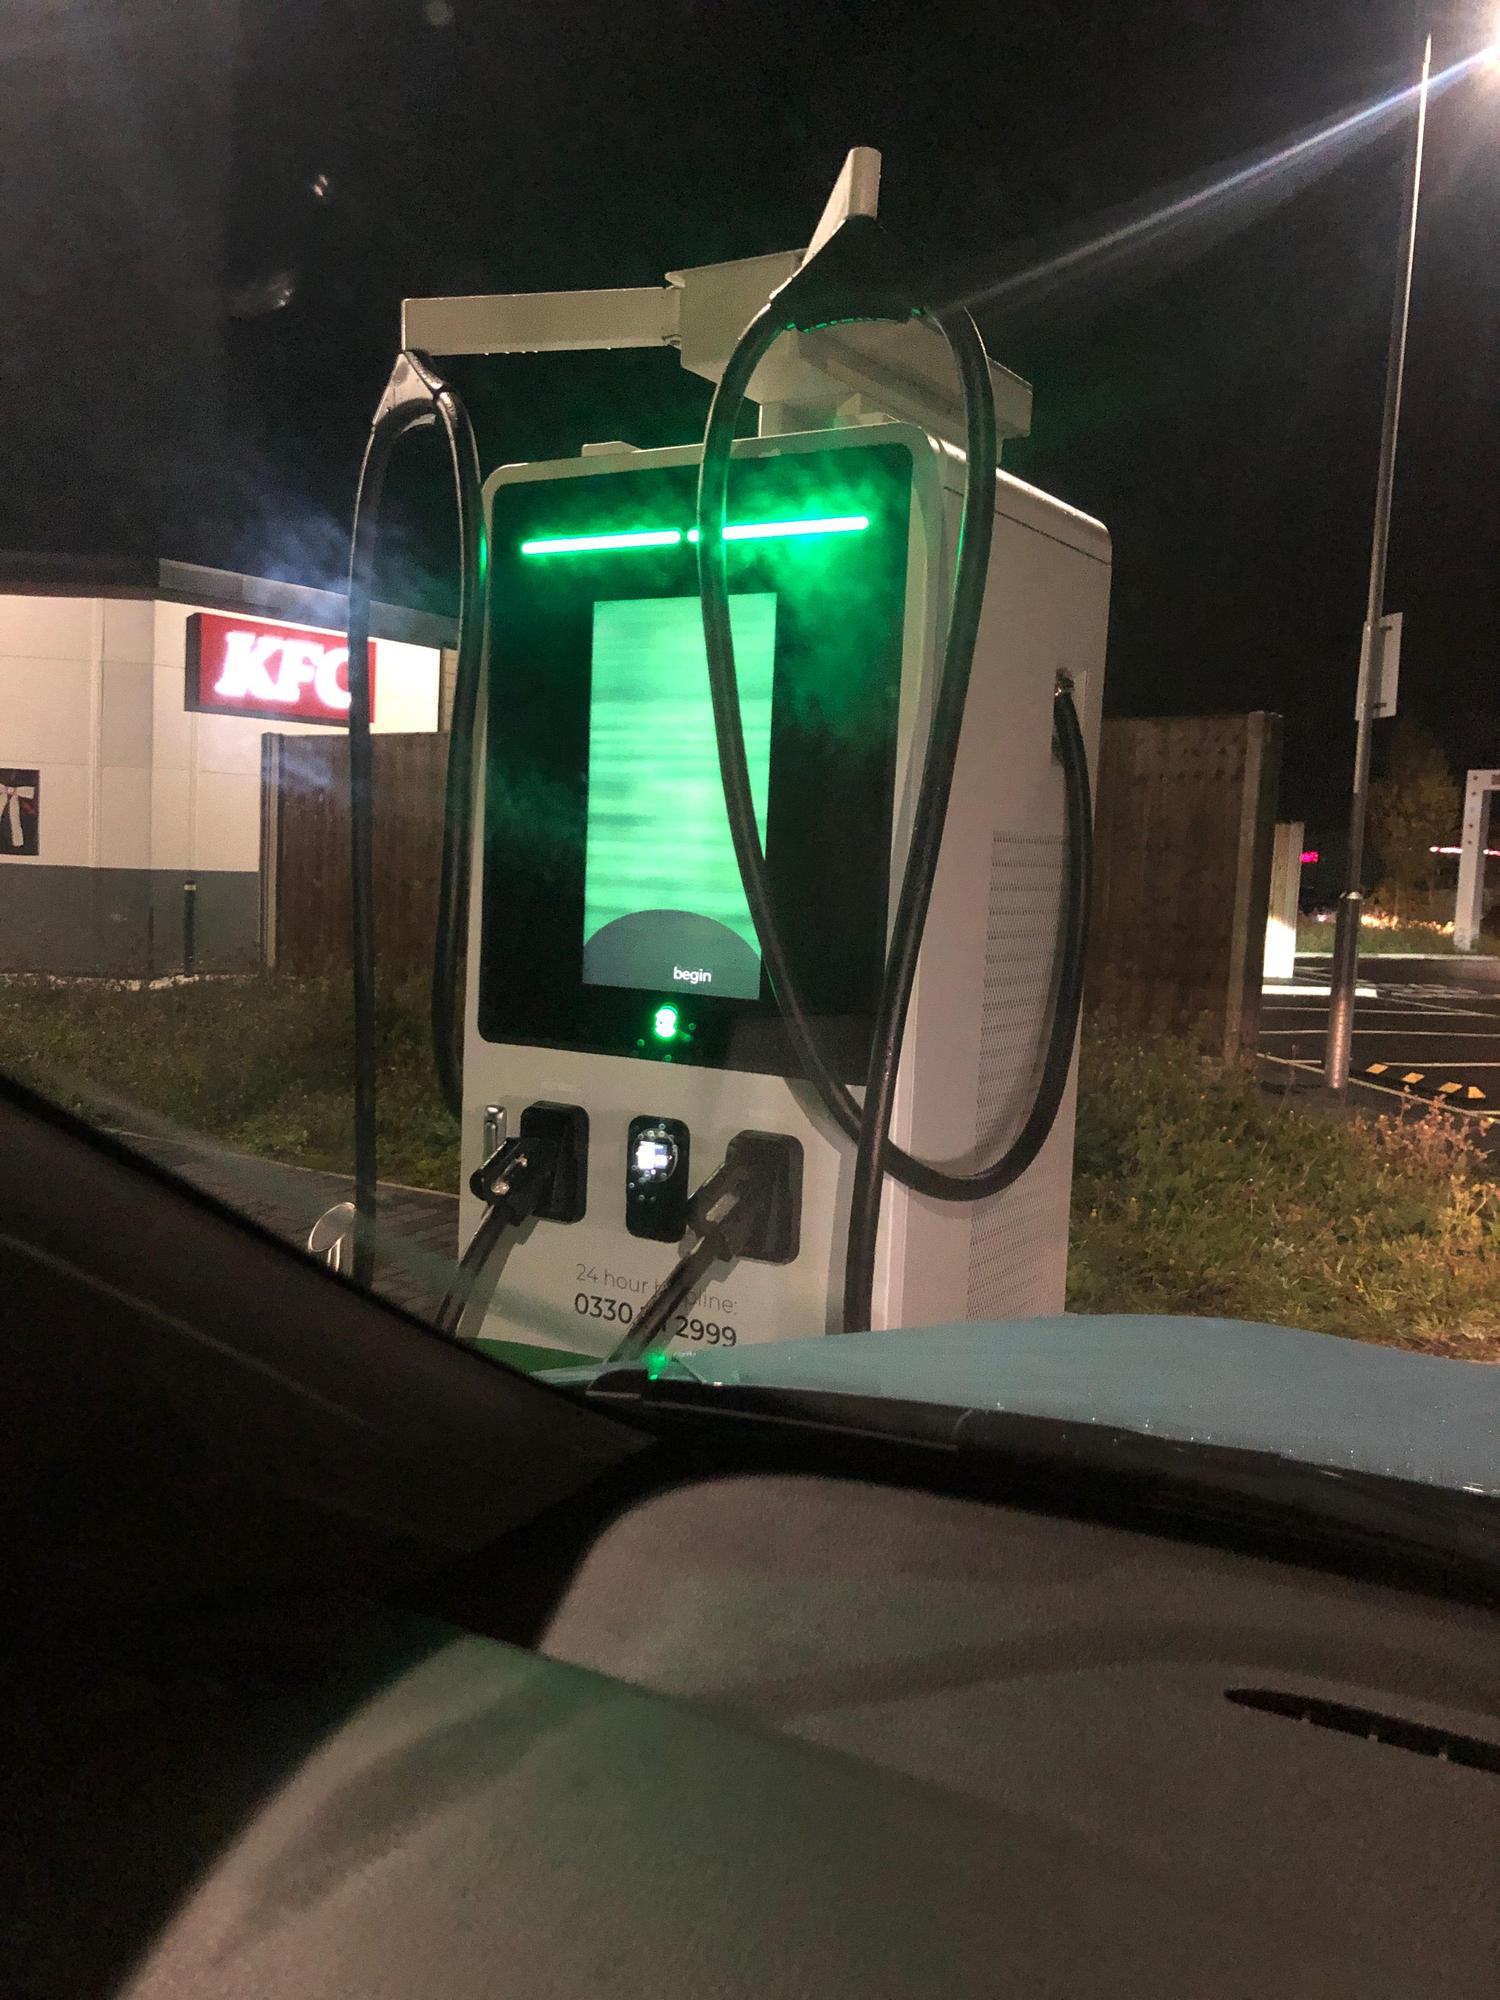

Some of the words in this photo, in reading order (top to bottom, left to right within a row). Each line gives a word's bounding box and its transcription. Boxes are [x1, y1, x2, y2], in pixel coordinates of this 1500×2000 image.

[214, 630, 351, 709] KFC
[673, 966, 712, 984] begin
[575, 1263, 599, 1282] 24
[603, 1268, 648, 1294] hour
[574, 1292, 633, 1324] 0330
[674, 1314, 737, 1347] 2999
